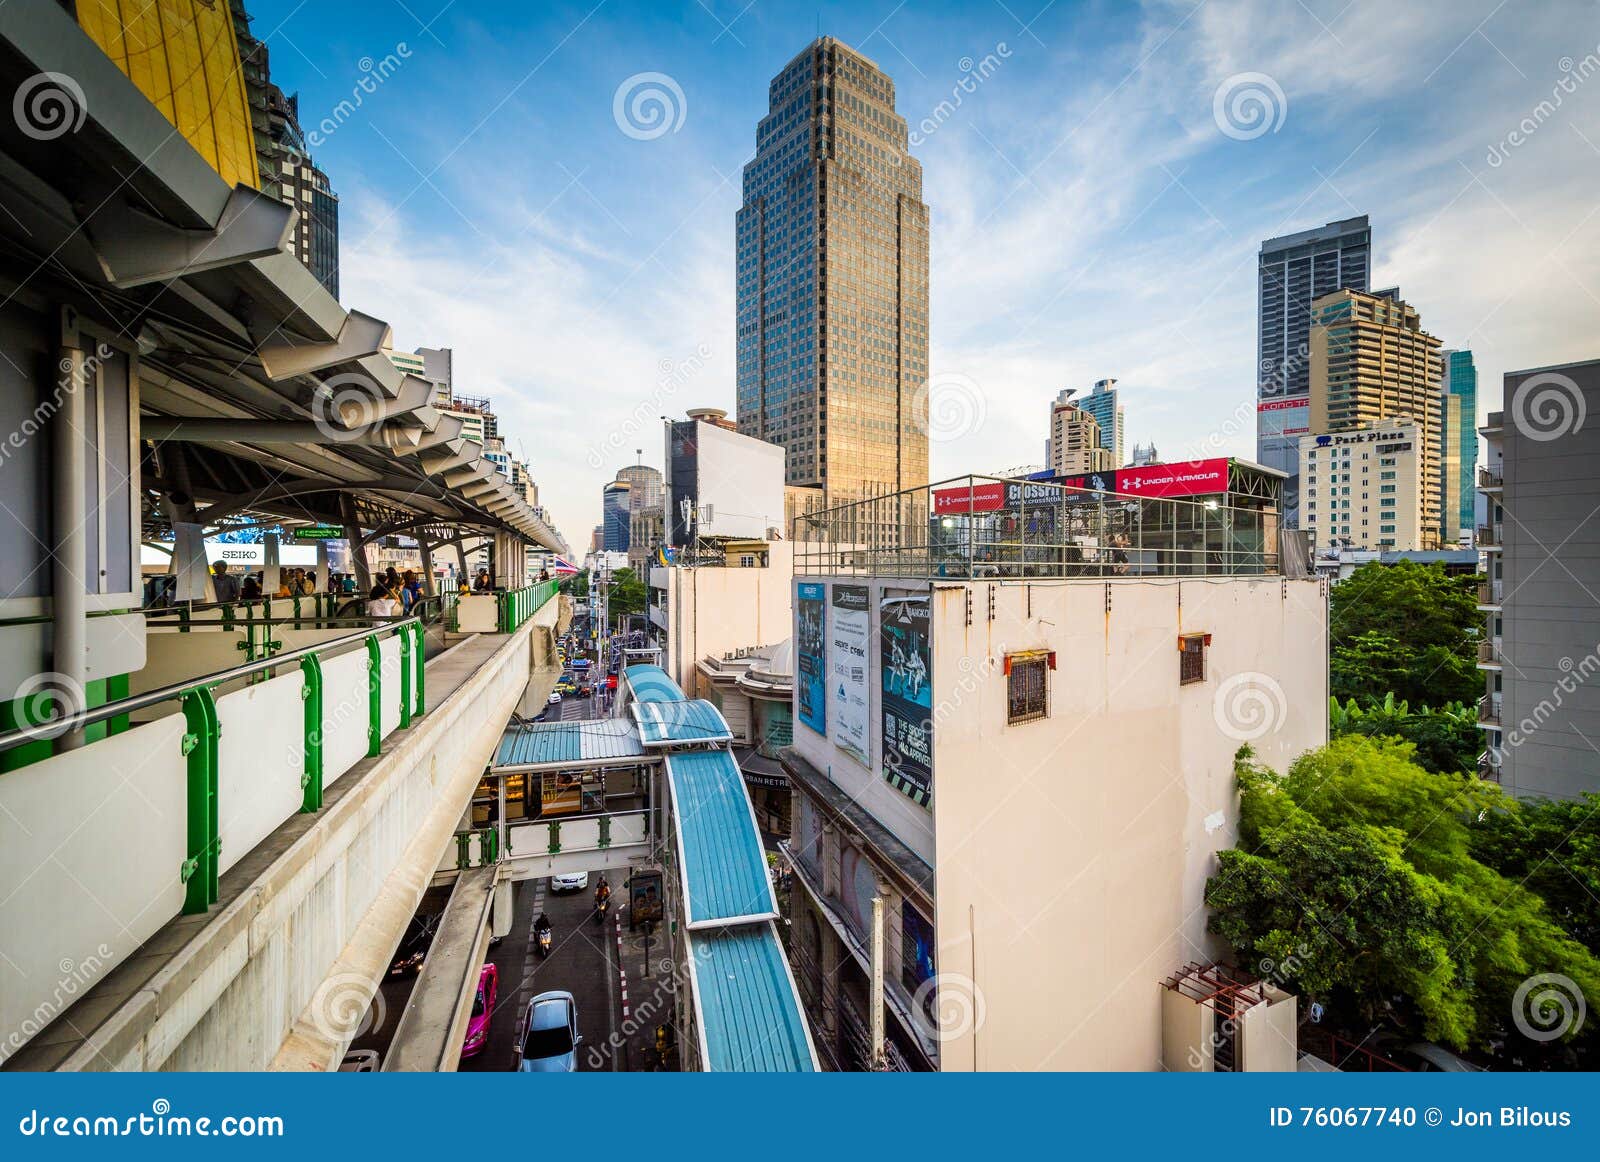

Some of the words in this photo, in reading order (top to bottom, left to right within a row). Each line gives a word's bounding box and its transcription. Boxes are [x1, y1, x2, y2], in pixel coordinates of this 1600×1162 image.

[1334, 434, 1365, 445] Park
[1367, 432, 1405, 442] Plaza
[1143, 477, 1173, 485] UNDER
[1176, 472, 1219, 481] ARMOUR
[222, 551, 257, 559] SEIKO
[898, 718, 908, 733] THE
[908, 724, 926, 741] SPORT
[898, 730, 906, 741] OF
[909, 747, 932, 768] ARRIVED
